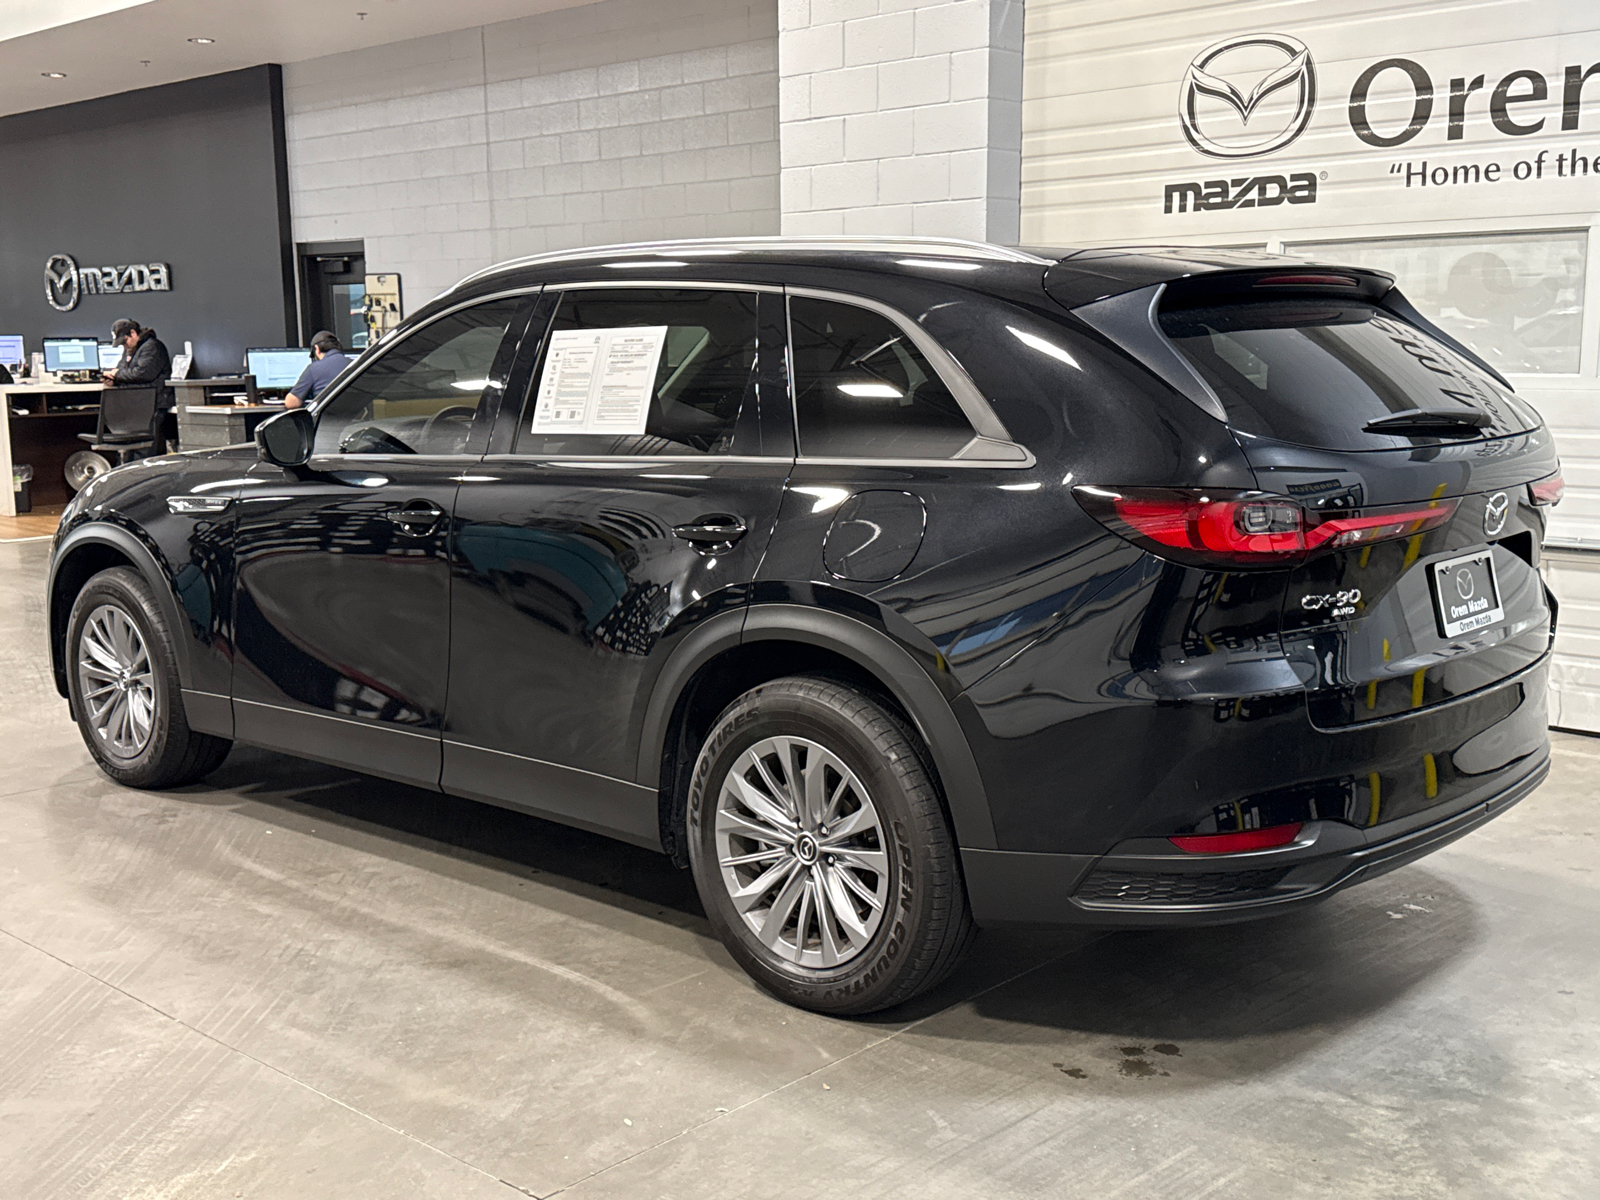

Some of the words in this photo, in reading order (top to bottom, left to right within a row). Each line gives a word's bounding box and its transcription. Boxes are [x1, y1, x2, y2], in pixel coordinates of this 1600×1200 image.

[1512, 150, 1549, 180] of
[1301, 588, 1361, 610] CX-90
[1450, 604, 1469, 619] Orem
[1467, 596, 1489, 613] Mazda
[1331, 606, 1356, 617] AWD
[1459, 620, 1475, 632] Orem
[1473, 614, 1492, 628] Mazda
[690, 755, 710, 828] TOYO
[707, 706, 760, 757] TIRES
[893, 820, 914, 915] OPEN
